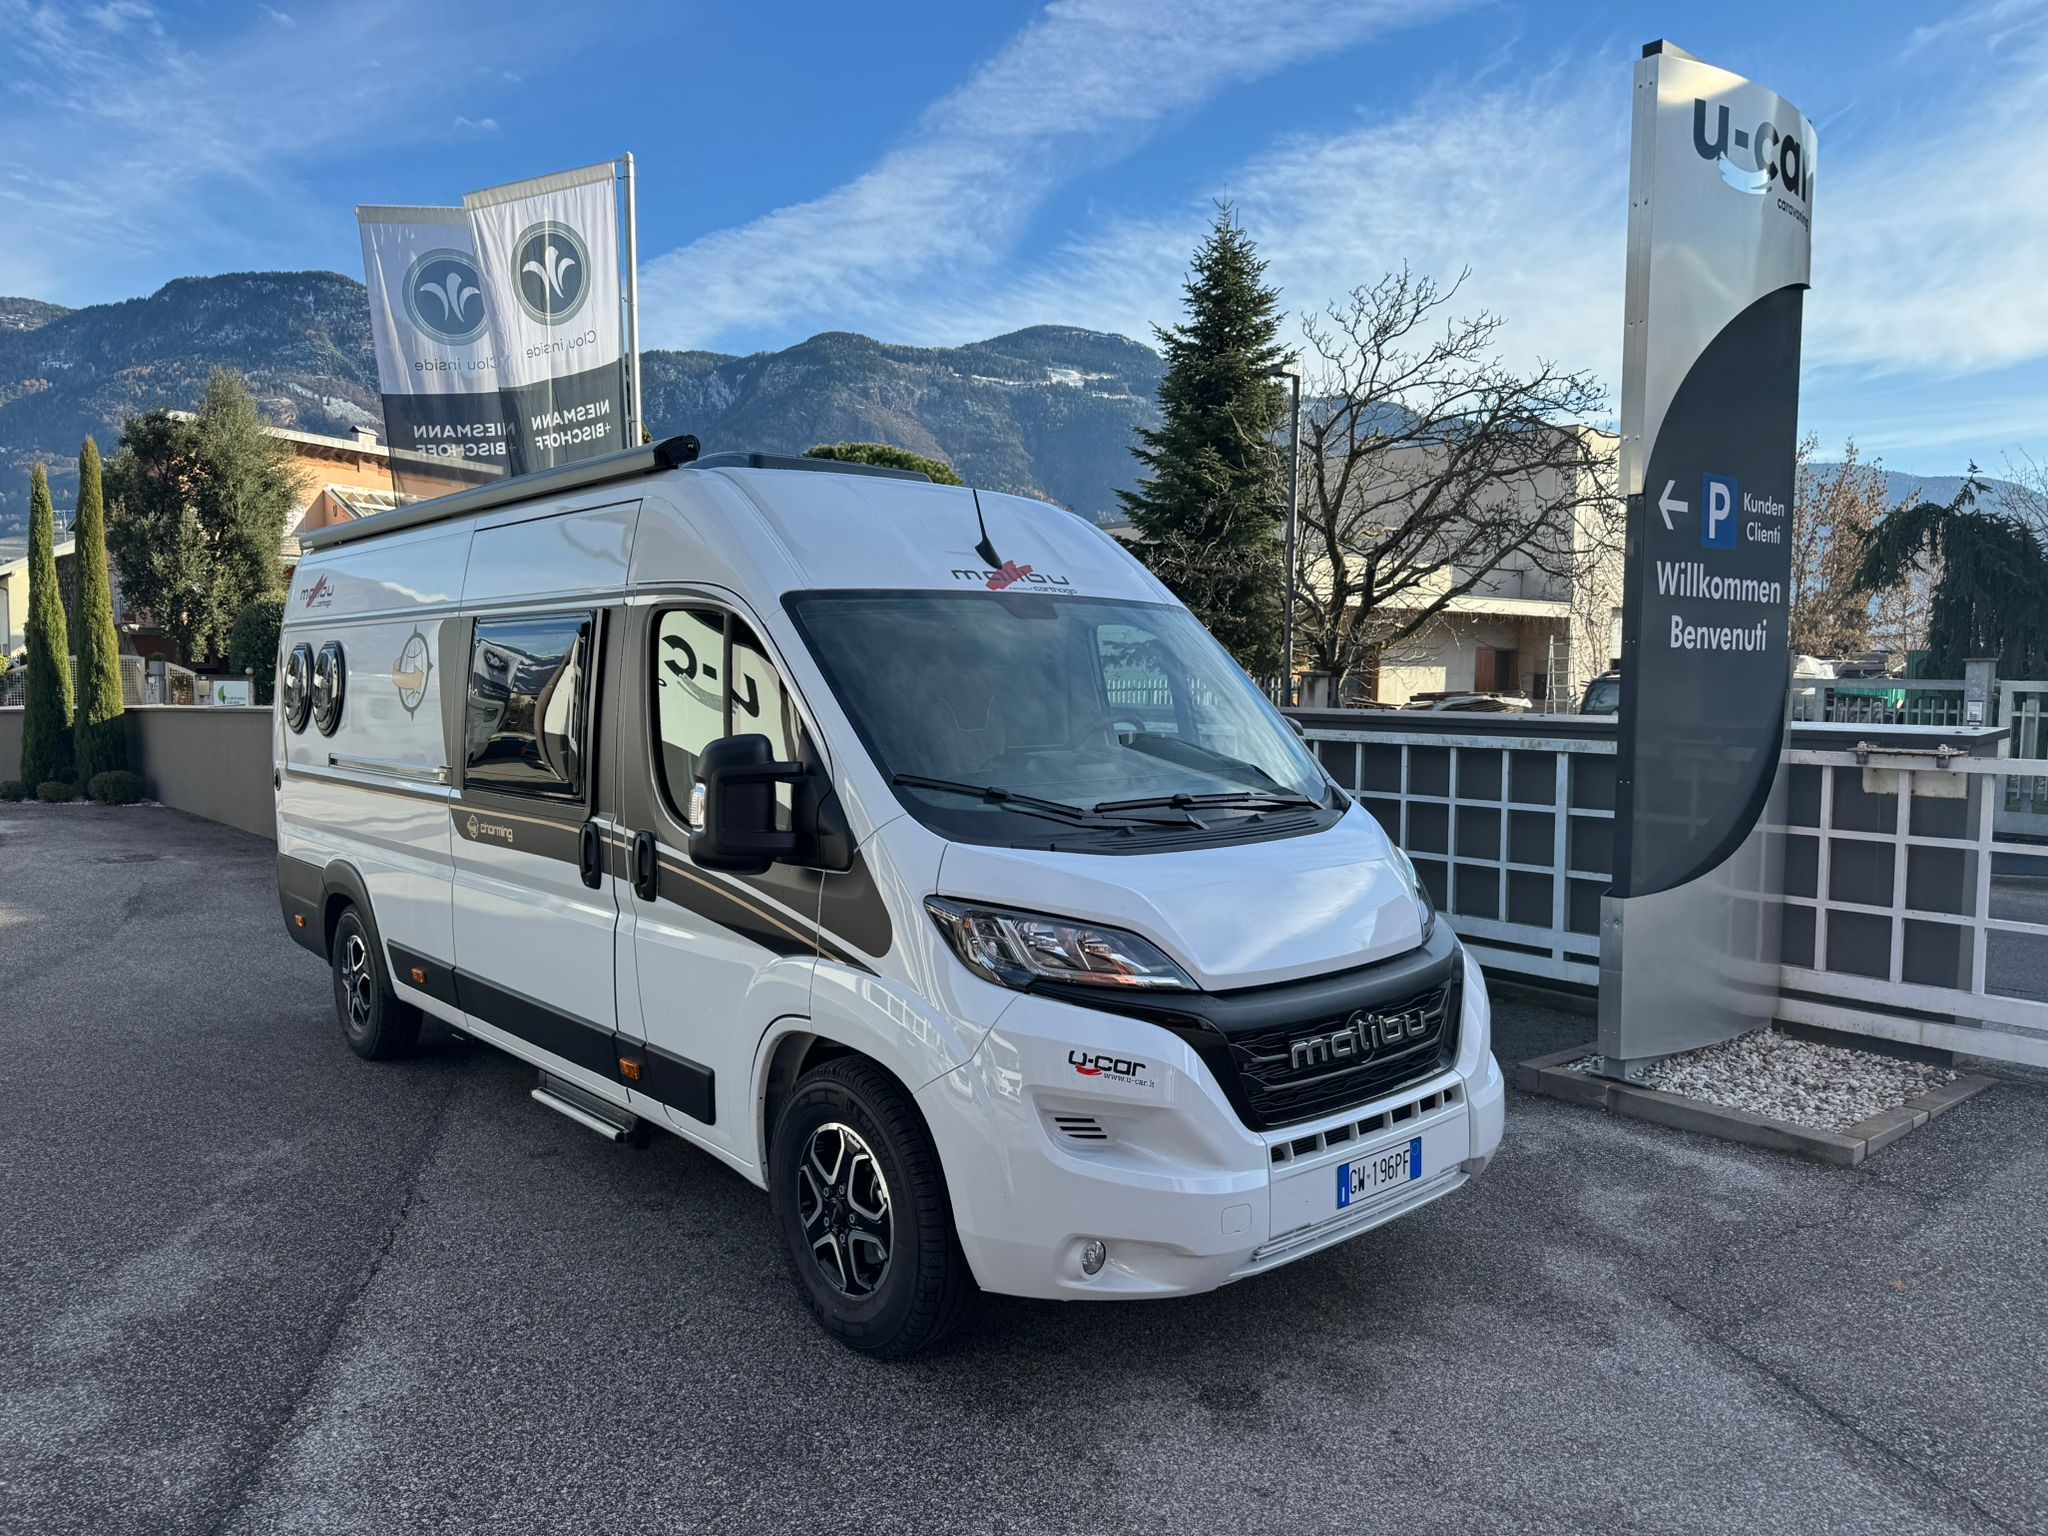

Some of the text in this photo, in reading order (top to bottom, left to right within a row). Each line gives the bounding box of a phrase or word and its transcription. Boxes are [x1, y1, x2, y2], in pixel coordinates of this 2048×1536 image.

[1708, 481, 1731, 539] P
[1743, 492, 1785, 517] Kunden
[1746, 521, 1781, 544] Clienti
[1656, 560, 1781, 603] Willkommen
[1670, 614, 1767, 651] Benvenuti
[1290, 1009, 1426, 1069] malibu
[1067, 1049, 1146, 1077] u-car
[1103, 1072, 1155, 1088] www.u-car.it
